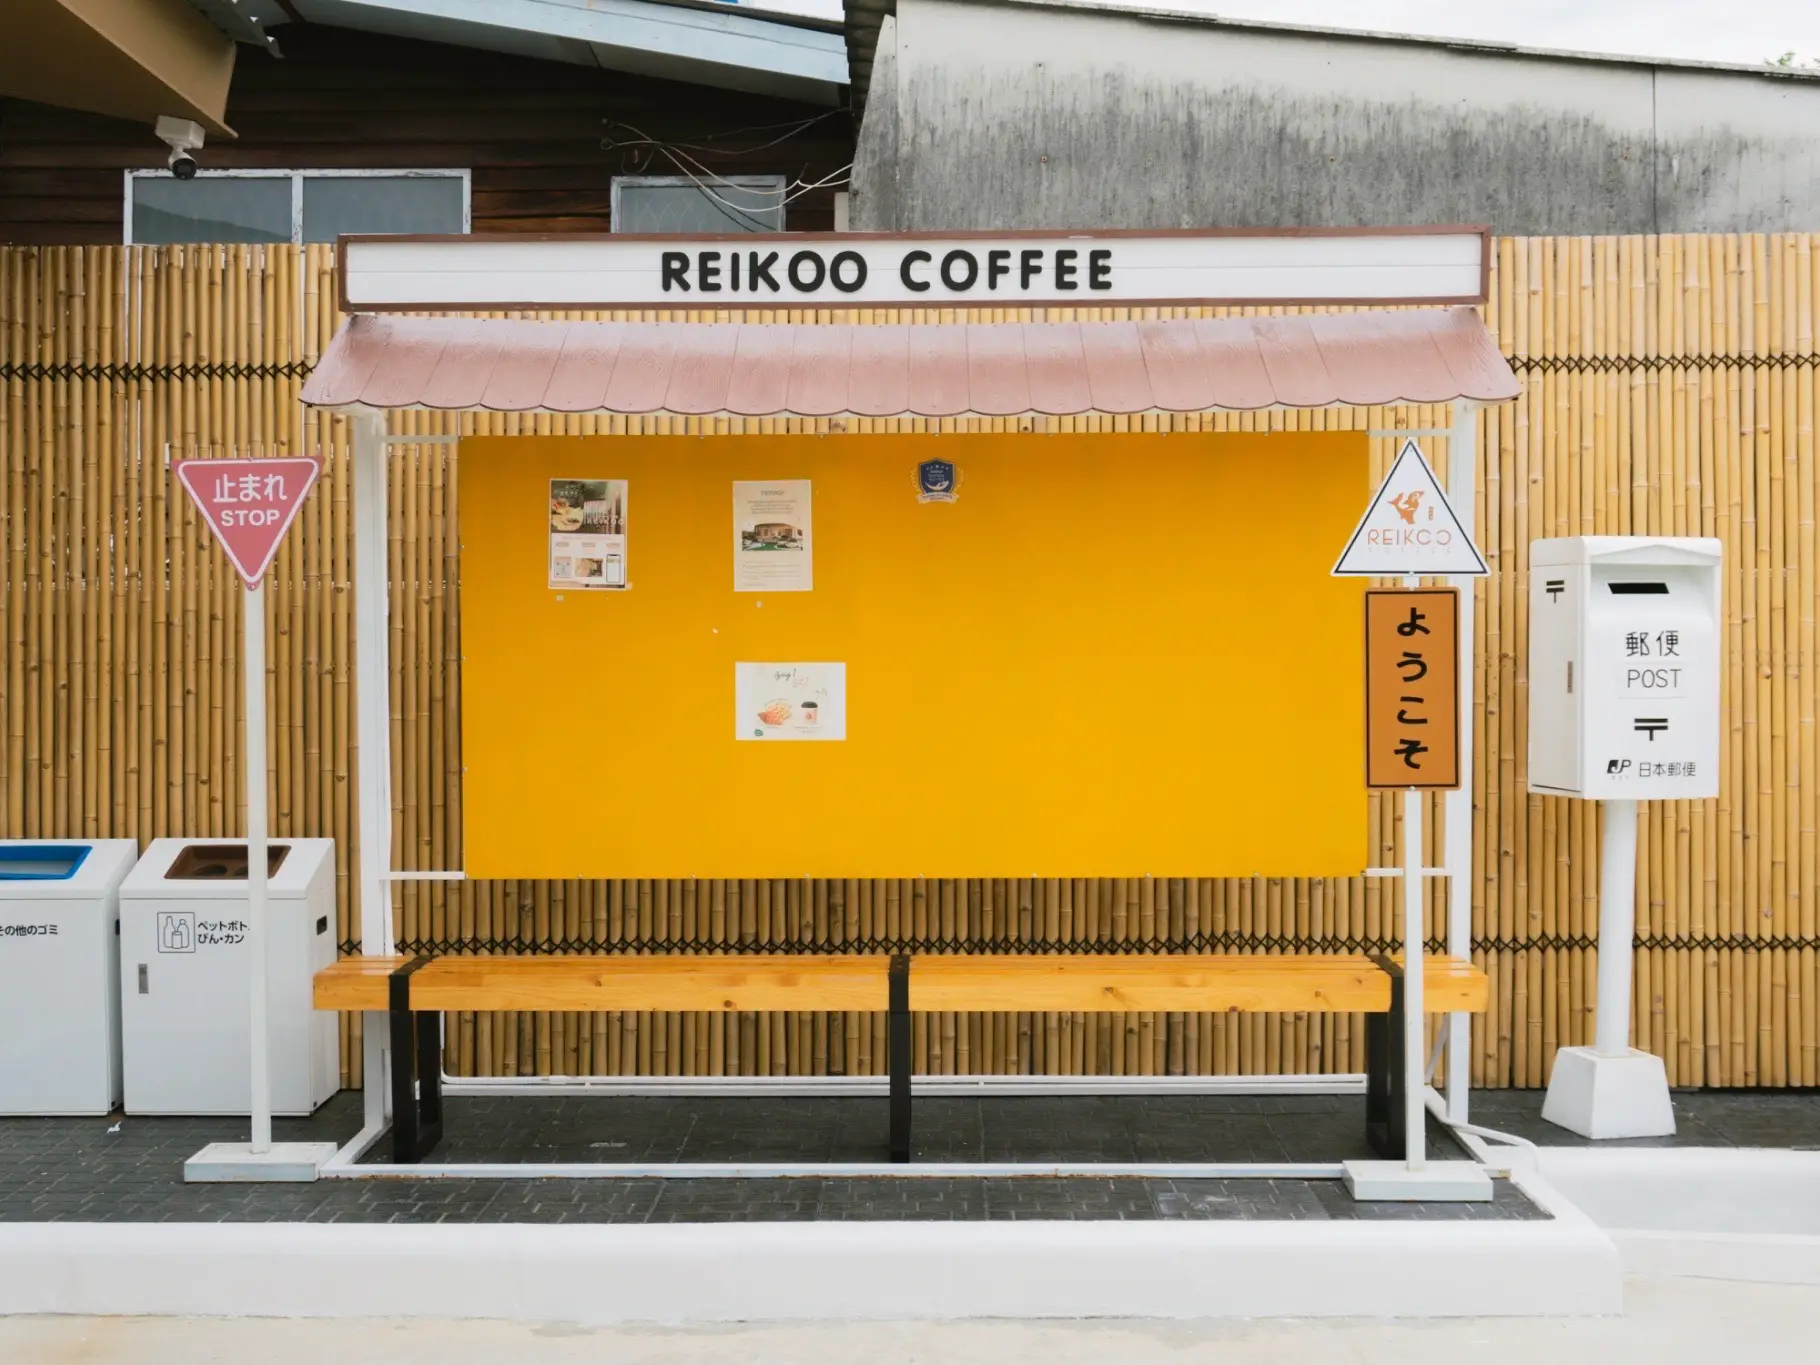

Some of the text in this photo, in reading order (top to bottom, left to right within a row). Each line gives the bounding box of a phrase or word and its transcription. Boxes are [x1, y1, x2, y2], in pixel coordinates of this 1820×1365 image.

[661, 249, 1113, 293] REIKOO COFFEE
[213, 473, 288, 503] 止まれ
[220, 509, 280, 527] STOP
[1625, 630, 1680, 658] 郵便
[1393, 606, 1431, 770] ようこそ
[1626, 668, 1682, 689] POST
[1639, 761, 1697, 778] 日本郵便
[197, 920, 250, 932] ペットボト
